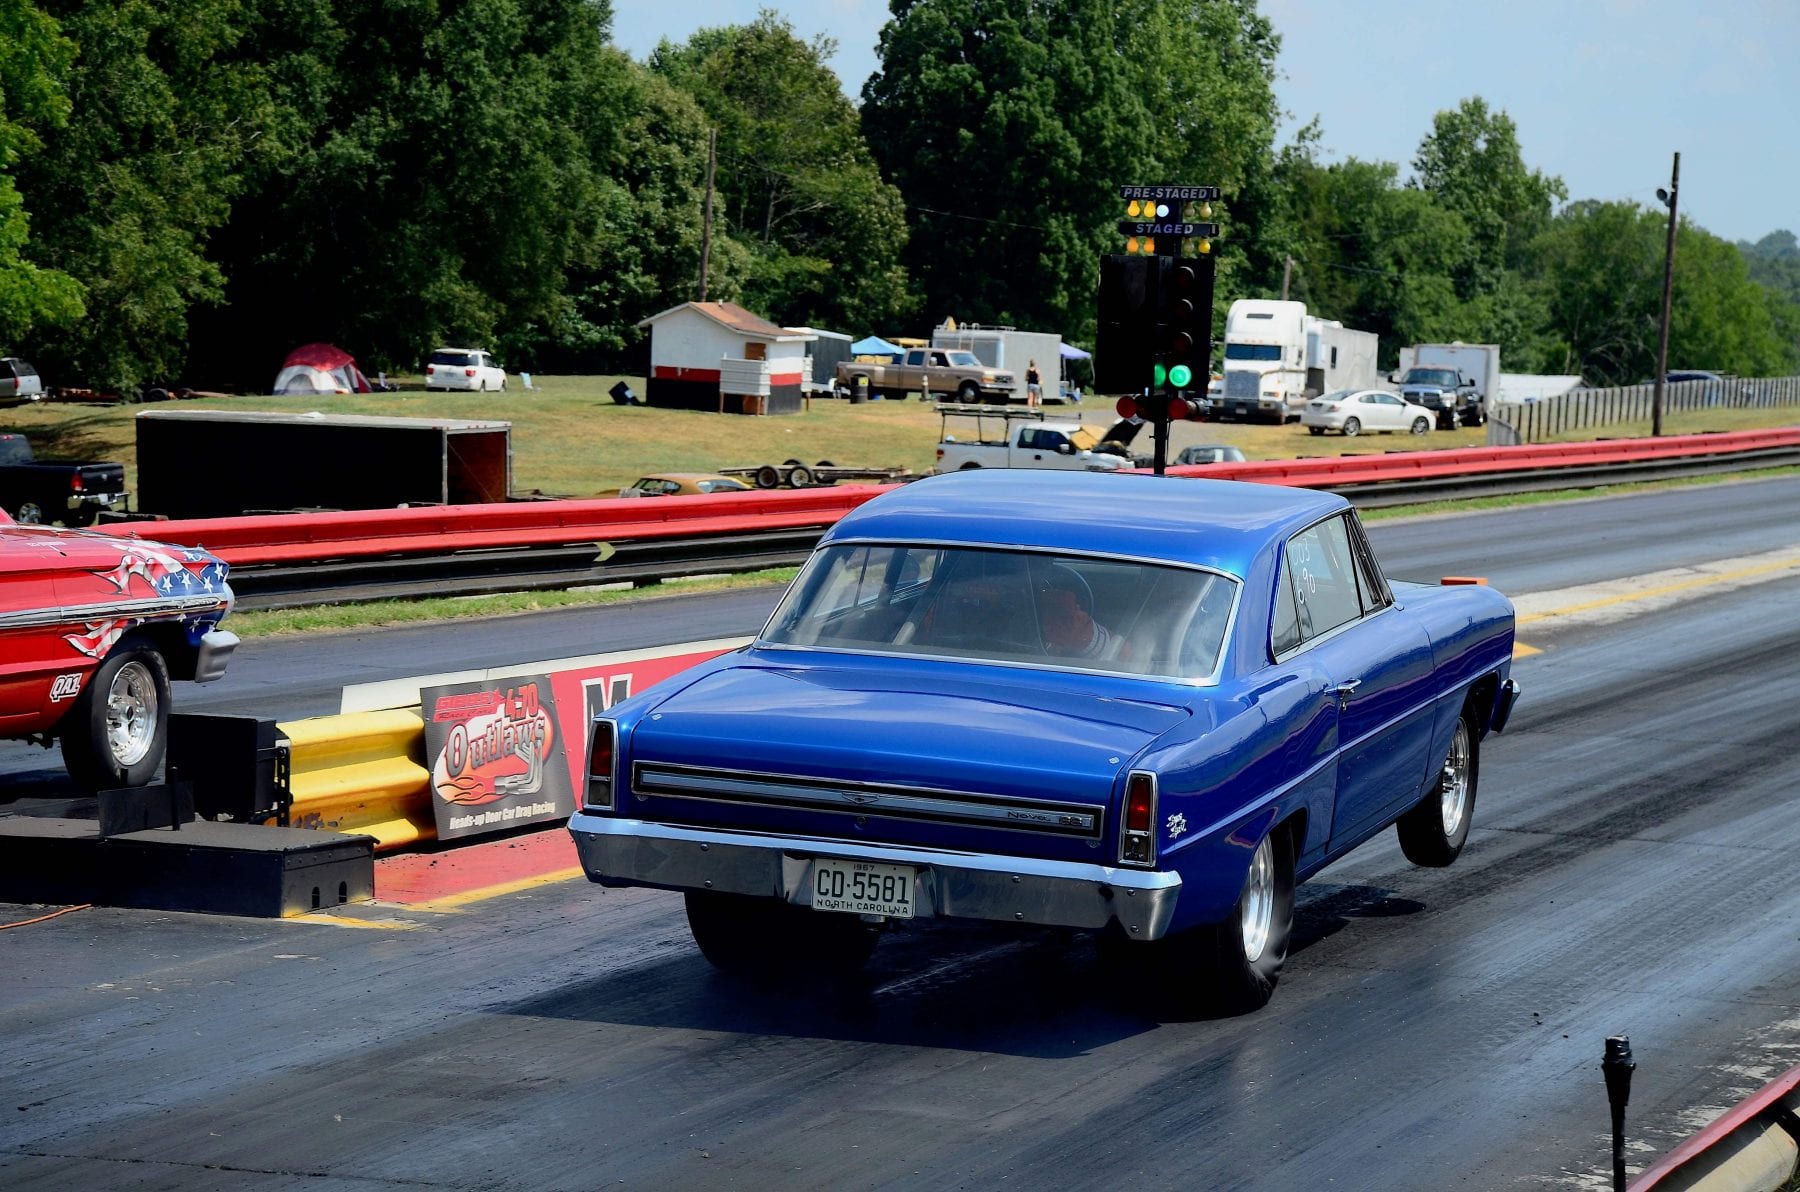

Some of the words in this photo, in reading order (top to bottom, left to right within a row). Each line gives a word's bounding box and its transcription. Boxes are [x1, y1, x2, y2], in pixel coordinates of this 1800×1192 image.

[1123, 187, 1208, 199] PRE-STAGED
[1135, 223, 1194, 235] STAGED
[445, 716, 546, 778] Outlaws
[532, 801, 555, 815] Racing
[817, 898, 853, 909] NORTH
[856, 902, 908, 914] CAROLINA
